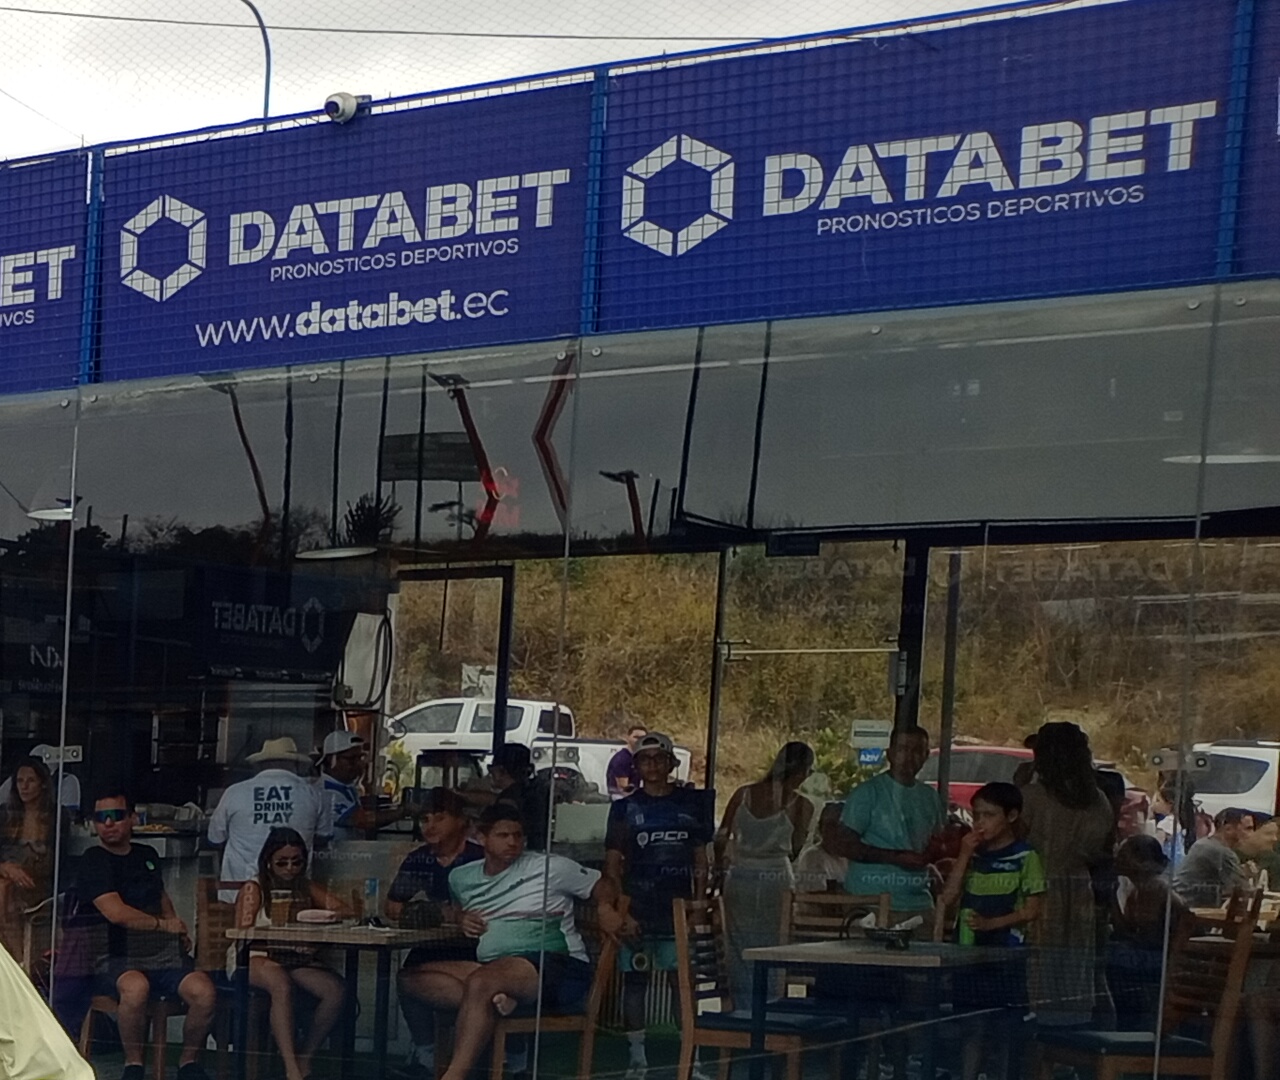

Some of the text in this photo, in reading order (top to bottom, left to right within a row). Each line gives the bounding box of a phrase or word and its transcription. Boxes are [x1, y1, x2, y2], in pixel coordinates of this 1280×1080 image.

[762, 100, 1216, 217] DATABET
[228, 168, 570, 267] DATABET
[817, 184, 1144, 236] PRONOSTICOS DEPORTIVOS
[270, 238, 519, 283] PRONOSTICOS DEPORTIVOS
[195, 289, 509, 348] www.databet.ec
[253, 785, 293, 801] EAT
[253, 802, 294, 812] DRINK
[253, 812, 293, 825] PLAY
